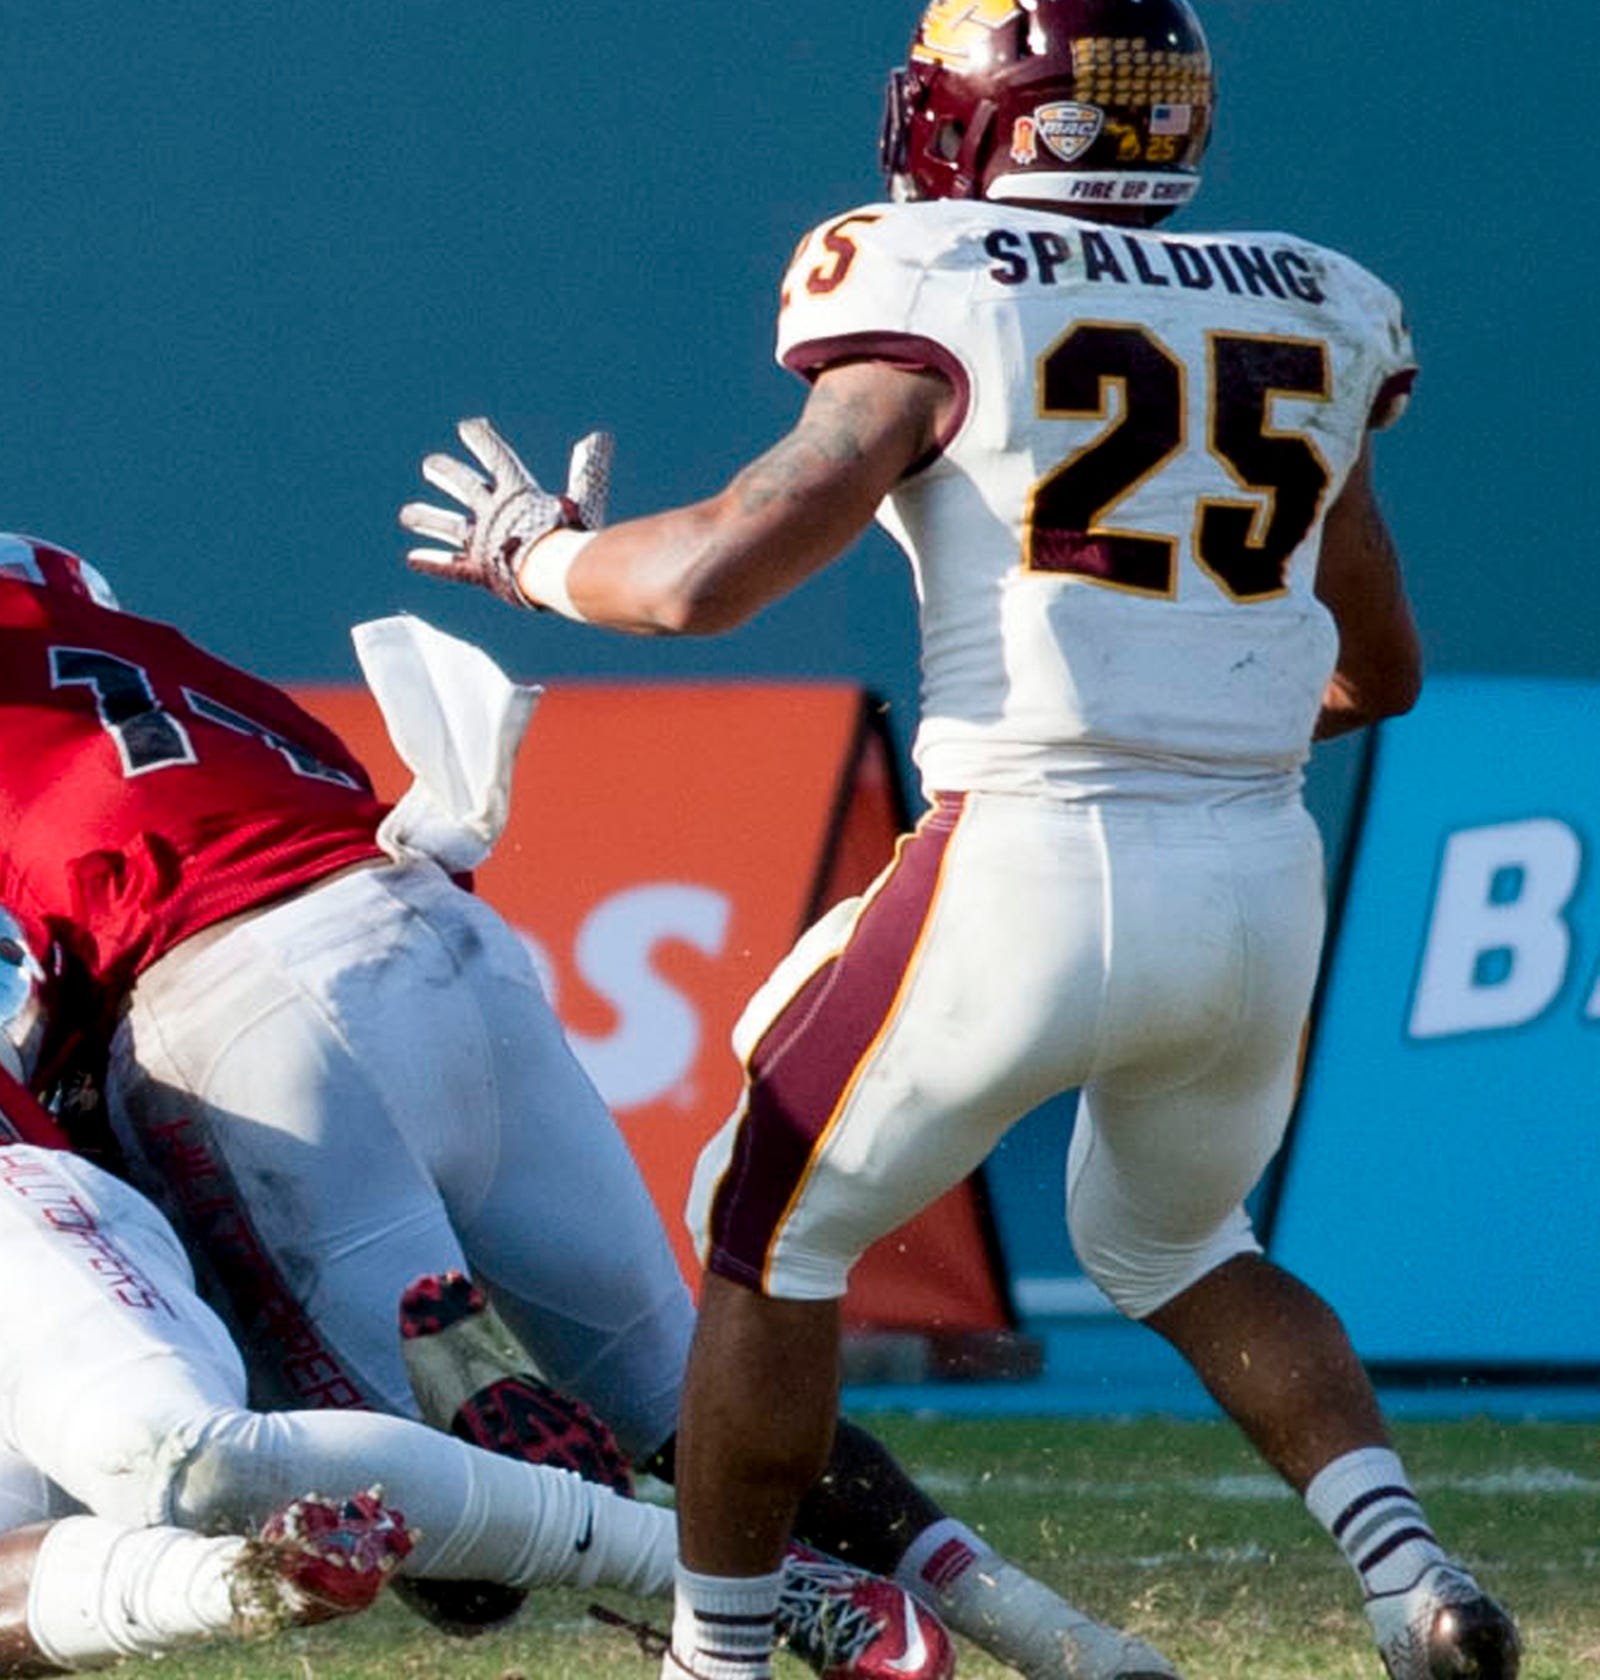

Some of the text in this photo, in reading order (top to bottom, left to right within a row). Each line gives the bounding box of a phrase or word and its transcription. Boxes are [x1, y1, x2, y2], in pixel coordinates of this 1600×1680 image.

[1069, 180, 1117, 200] FIRE
[1121, 180, 1149, 200] UP
[1146, 135, 1175, 161] 25
[780, 212, 885, 308] 5
[984, 229, 1327, 304] SPALDING
[1023, 318, 1333, 604] 25
[1408, 816, 1600, 1040] B
